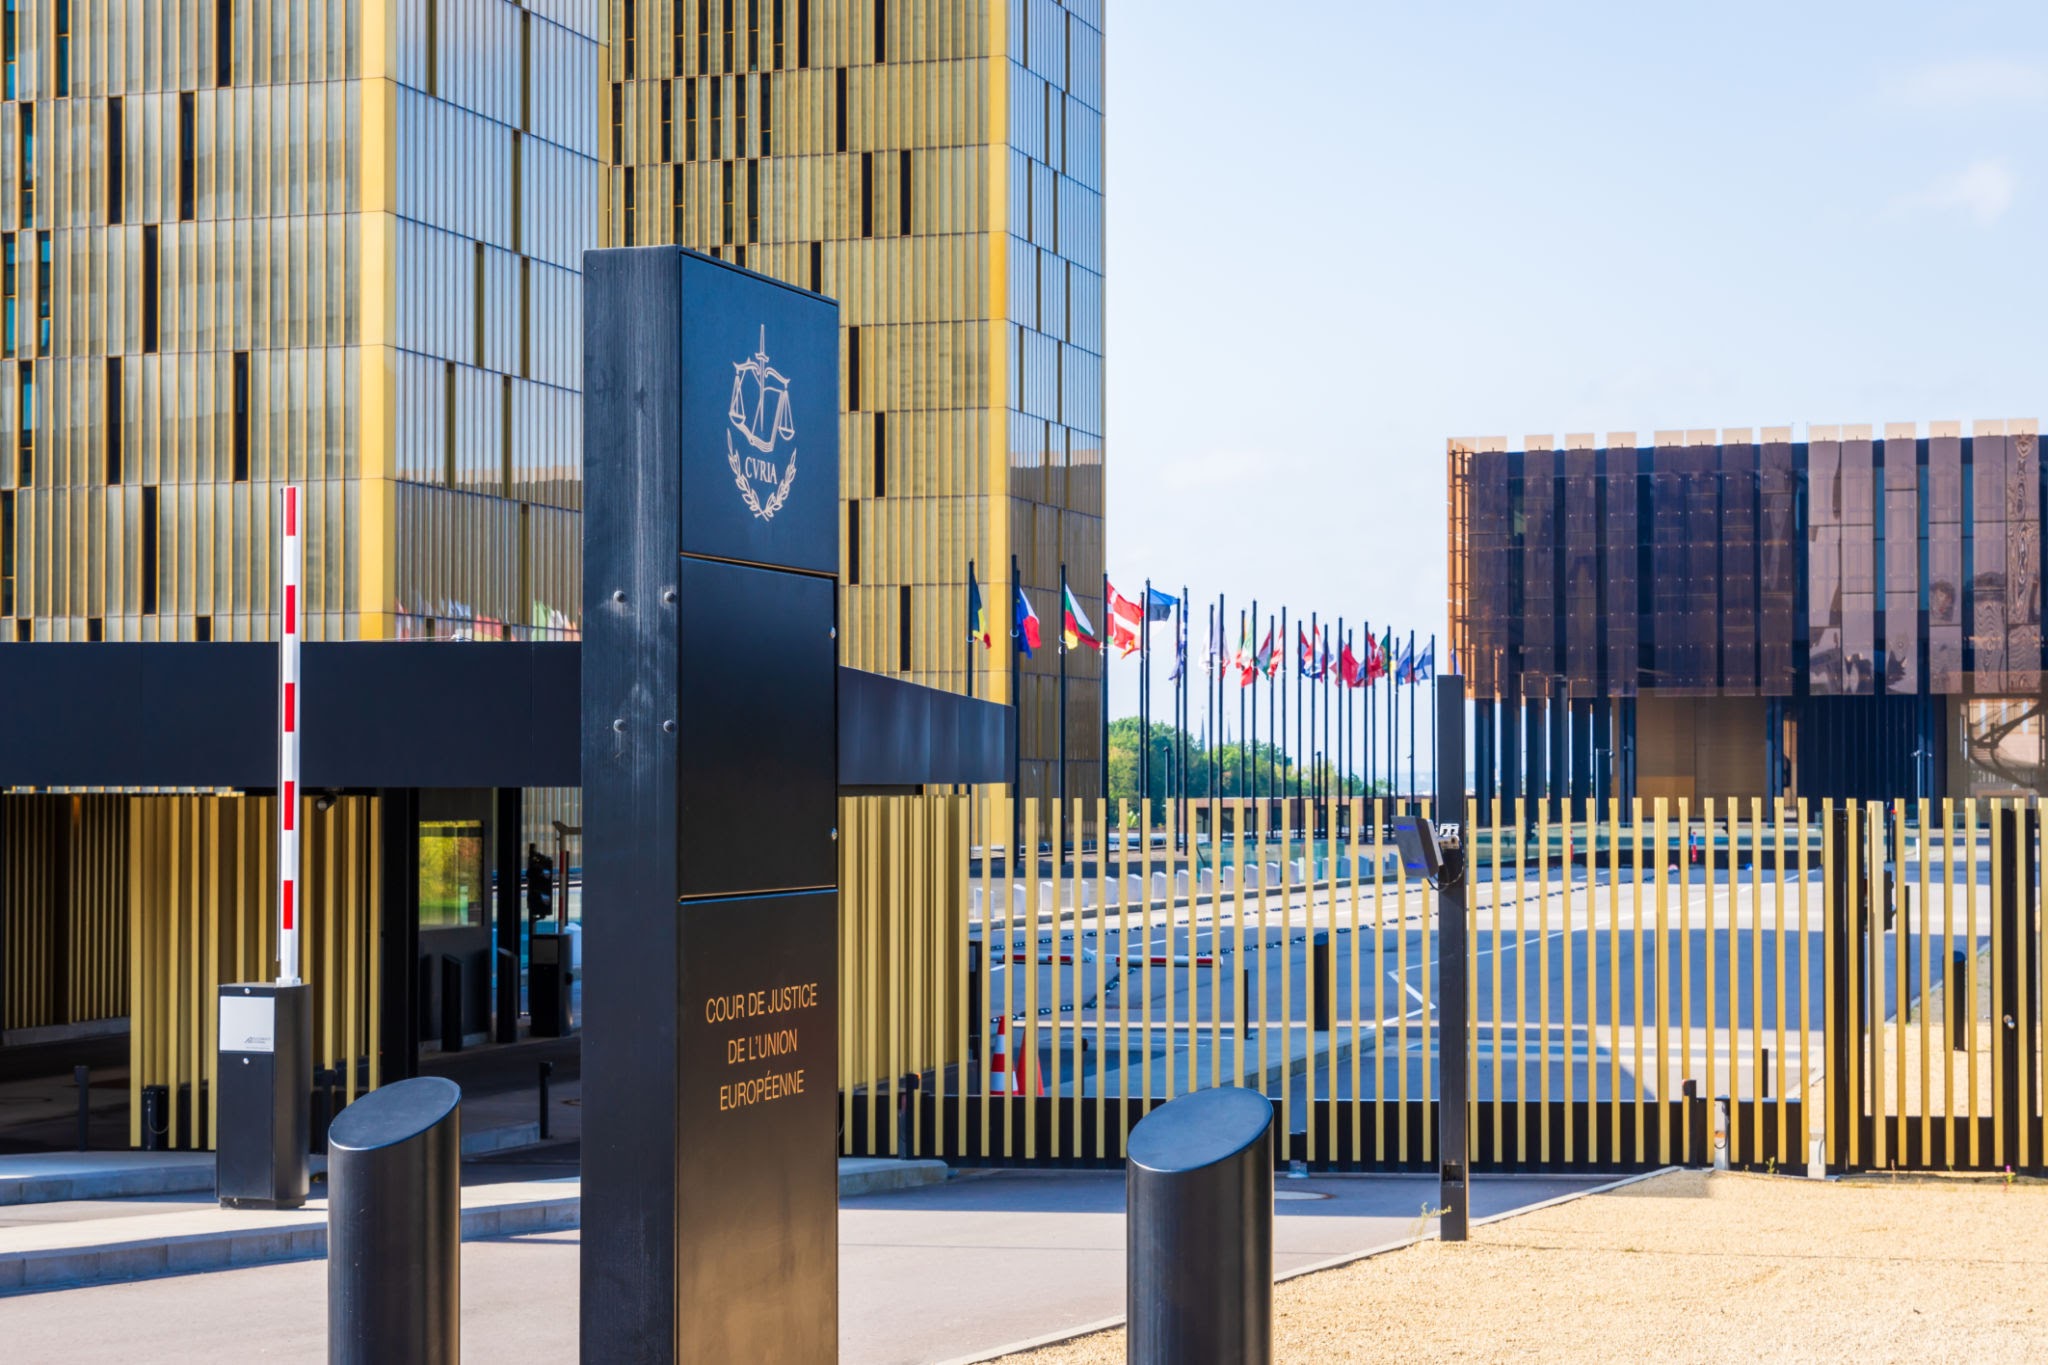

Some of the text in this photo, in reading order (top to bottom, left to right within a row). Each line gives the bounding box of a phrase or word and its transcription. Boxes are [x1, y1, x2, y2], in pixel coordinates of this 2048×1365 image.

[744, 456, 778, 485] CVRIA
[705, 982, 818, 1024] COUR DE JUSTICE
[727, 1028, 798, 1065] DE L'UNION
[720, 1069, 804, 1111] EUROPÉENNE
